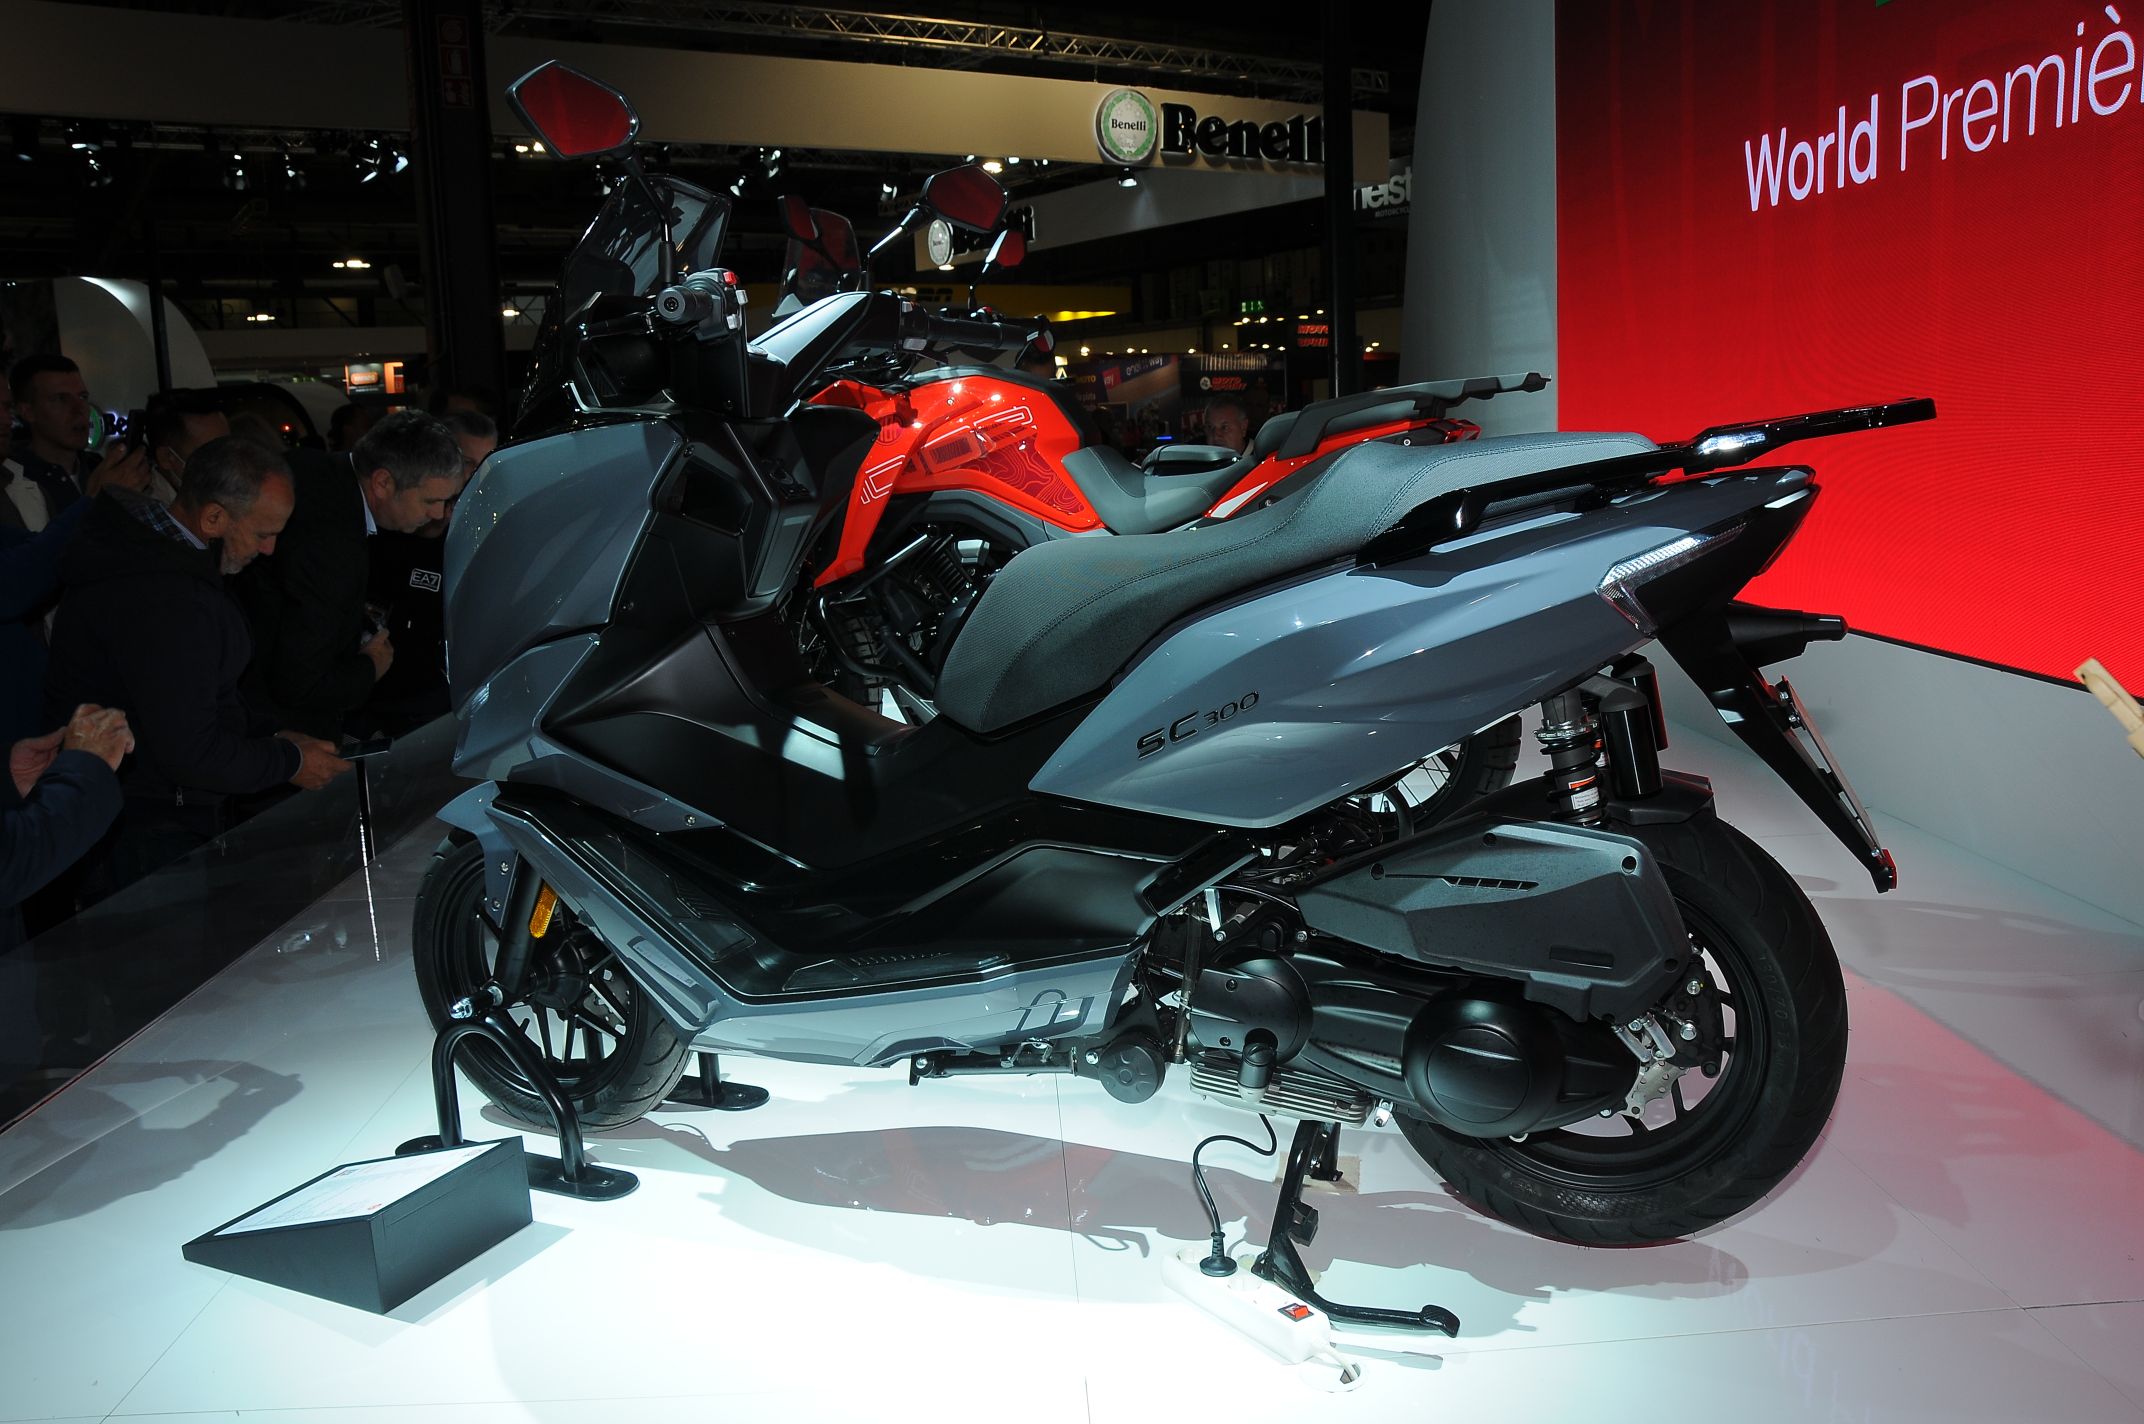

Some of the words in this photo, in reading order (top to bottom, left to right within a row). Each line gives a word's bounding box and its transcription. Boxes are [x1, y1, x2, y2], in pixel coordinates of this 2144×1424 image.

[1111, 118, 1146, 131] Benelli
[1745, 93, 1878, 211] World
[1900, 5, 2144, 171] Premiè
[1160, 102, 1325, 164] Benell
[412, 570, 438, 585] EA7
